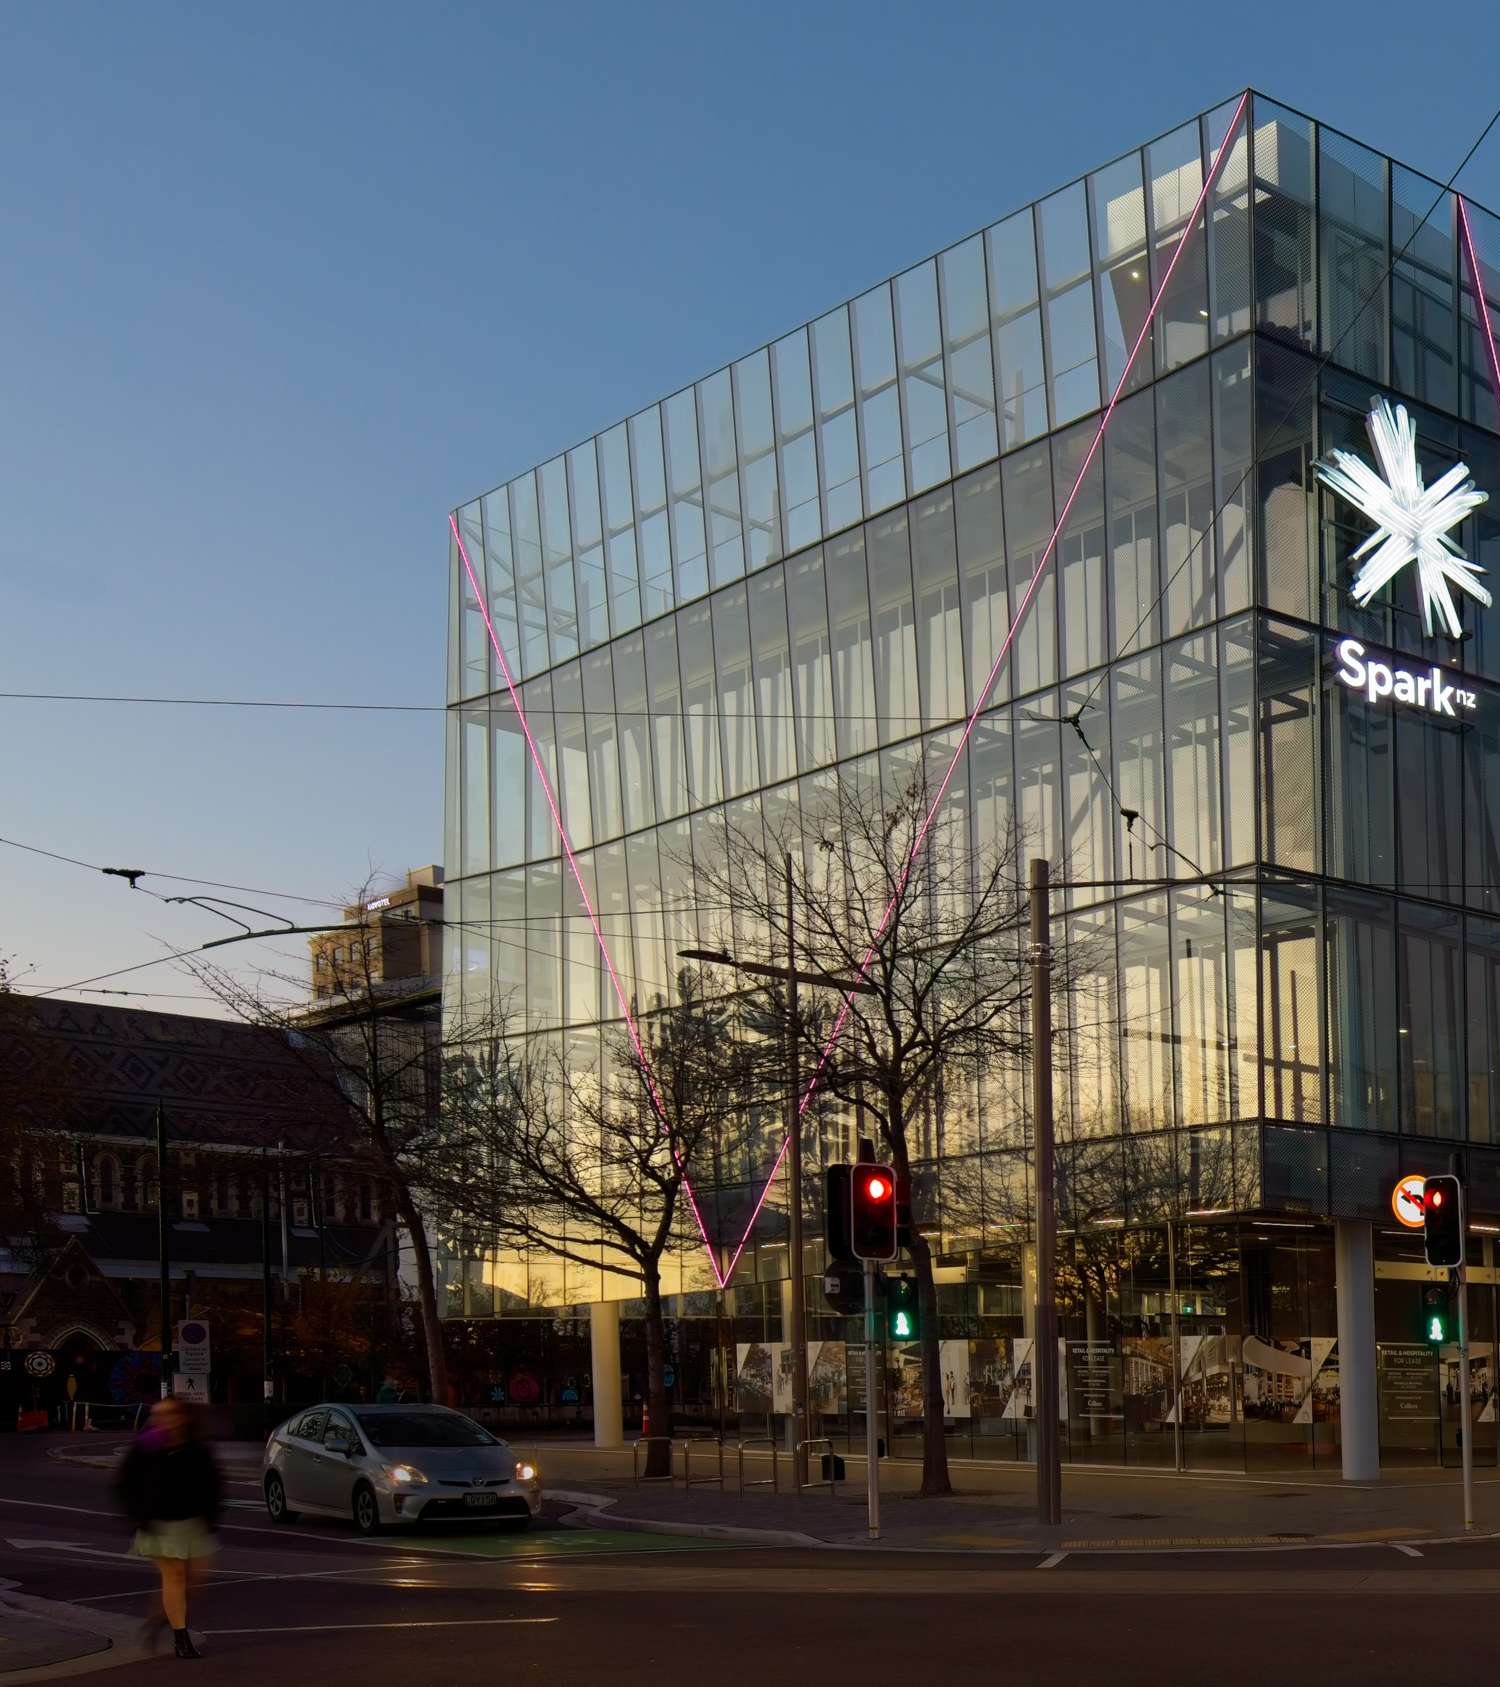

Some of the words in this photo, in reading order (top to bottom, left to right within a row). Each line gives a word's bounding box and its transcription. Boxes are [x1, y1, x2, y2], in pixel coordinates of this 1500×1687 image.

[1337, 639, 1456, 717] Spark
[1456, 689, 1477, 709] nz
[367, 897, 391, 911] NOVOTEL
